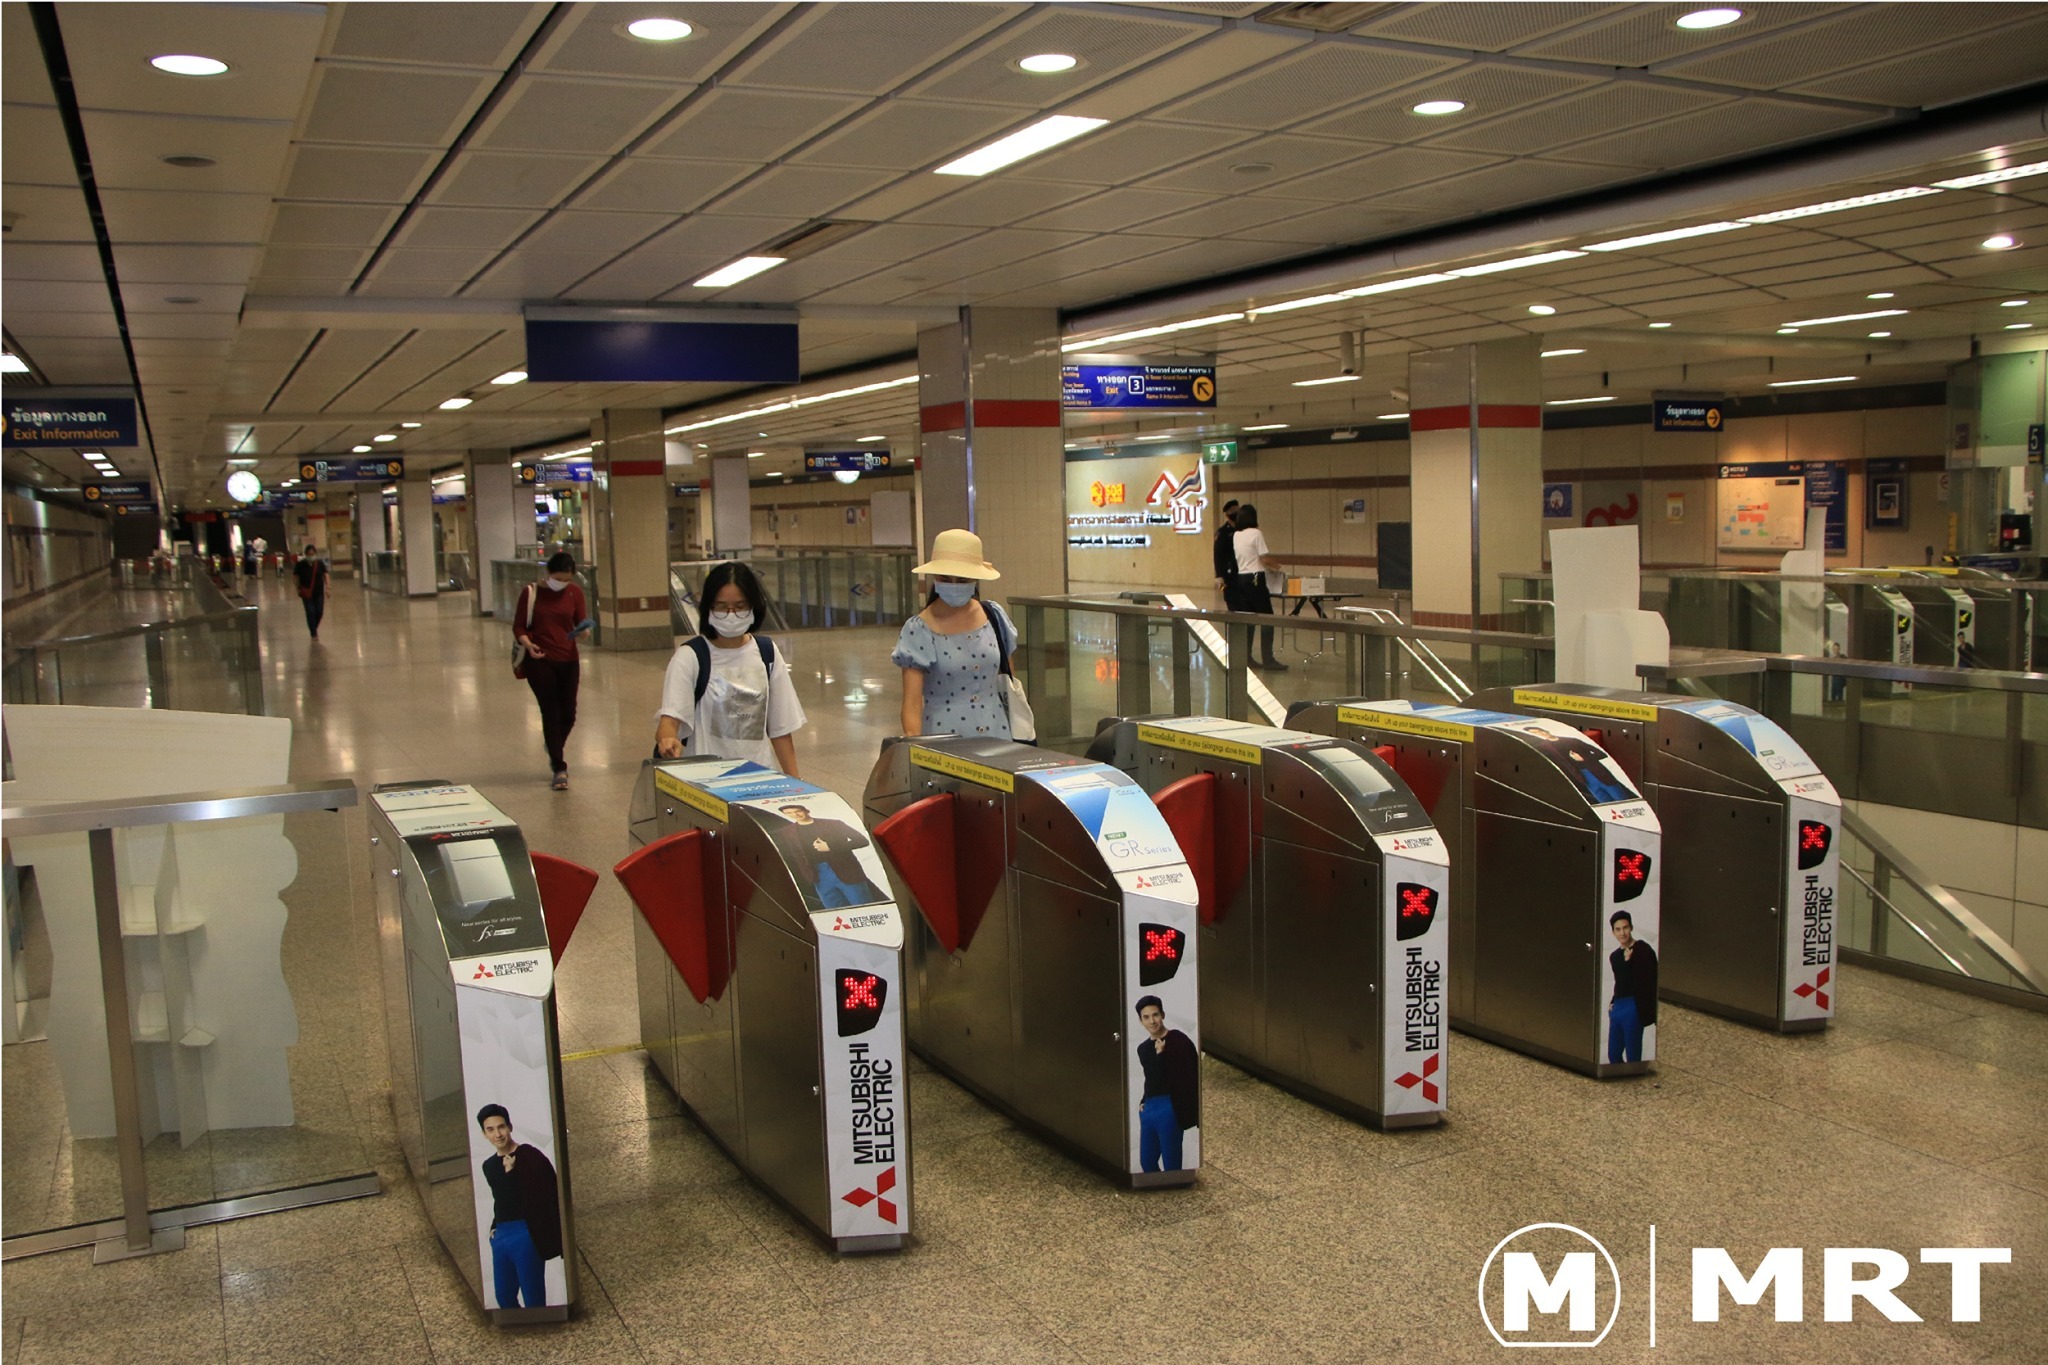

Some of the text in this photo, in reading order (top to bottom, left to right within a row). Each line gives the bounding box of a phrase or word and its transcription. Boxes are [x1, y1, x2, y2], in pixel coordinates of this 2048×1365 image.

[1096, 375, 1127, 384] ทางออก
[1133, 379, 1140, 391] 3
[1105, 386, 1119, 394] Exit
[11, 407, 107, 427] ข้อมูลทางออก
[13, 428, 120, 440] Exit Information
[2030, 428, 2039, 450] 5
[1616, 706, 1630, 714] above
[1434, 725, 1448, 734] above
[1404, 836, 1434, 845] MITSUBISHI
[1407, 841, 1432, 849] ELECTRIC
[1109, 840, 1144, 858] GR
[1149, 872, 1184, 881] MITSUBISHI
[1152, 878, 1182, 887] ELECTRIC
[850, 913, 889, 923] MITSUBISHI
[1803, 875, 1818, 966] MITSUBISHI
[852, 919, 886, 929] ELECTRIC
[1817, 886, 1832, 965] ELECTRIC
[494, 960, 539, 970] MITSUBISHI
[495, 966, 533, 977] ELECTRIC
[1405, 947, 1422, 1052] MITSUBISHI
[1423, 960, 1440, 1050] ELECTRIC
[849, 1042, 874, 1165] MITSUBISHI
[871, 1058, 896, 1164] ELECTRIC
